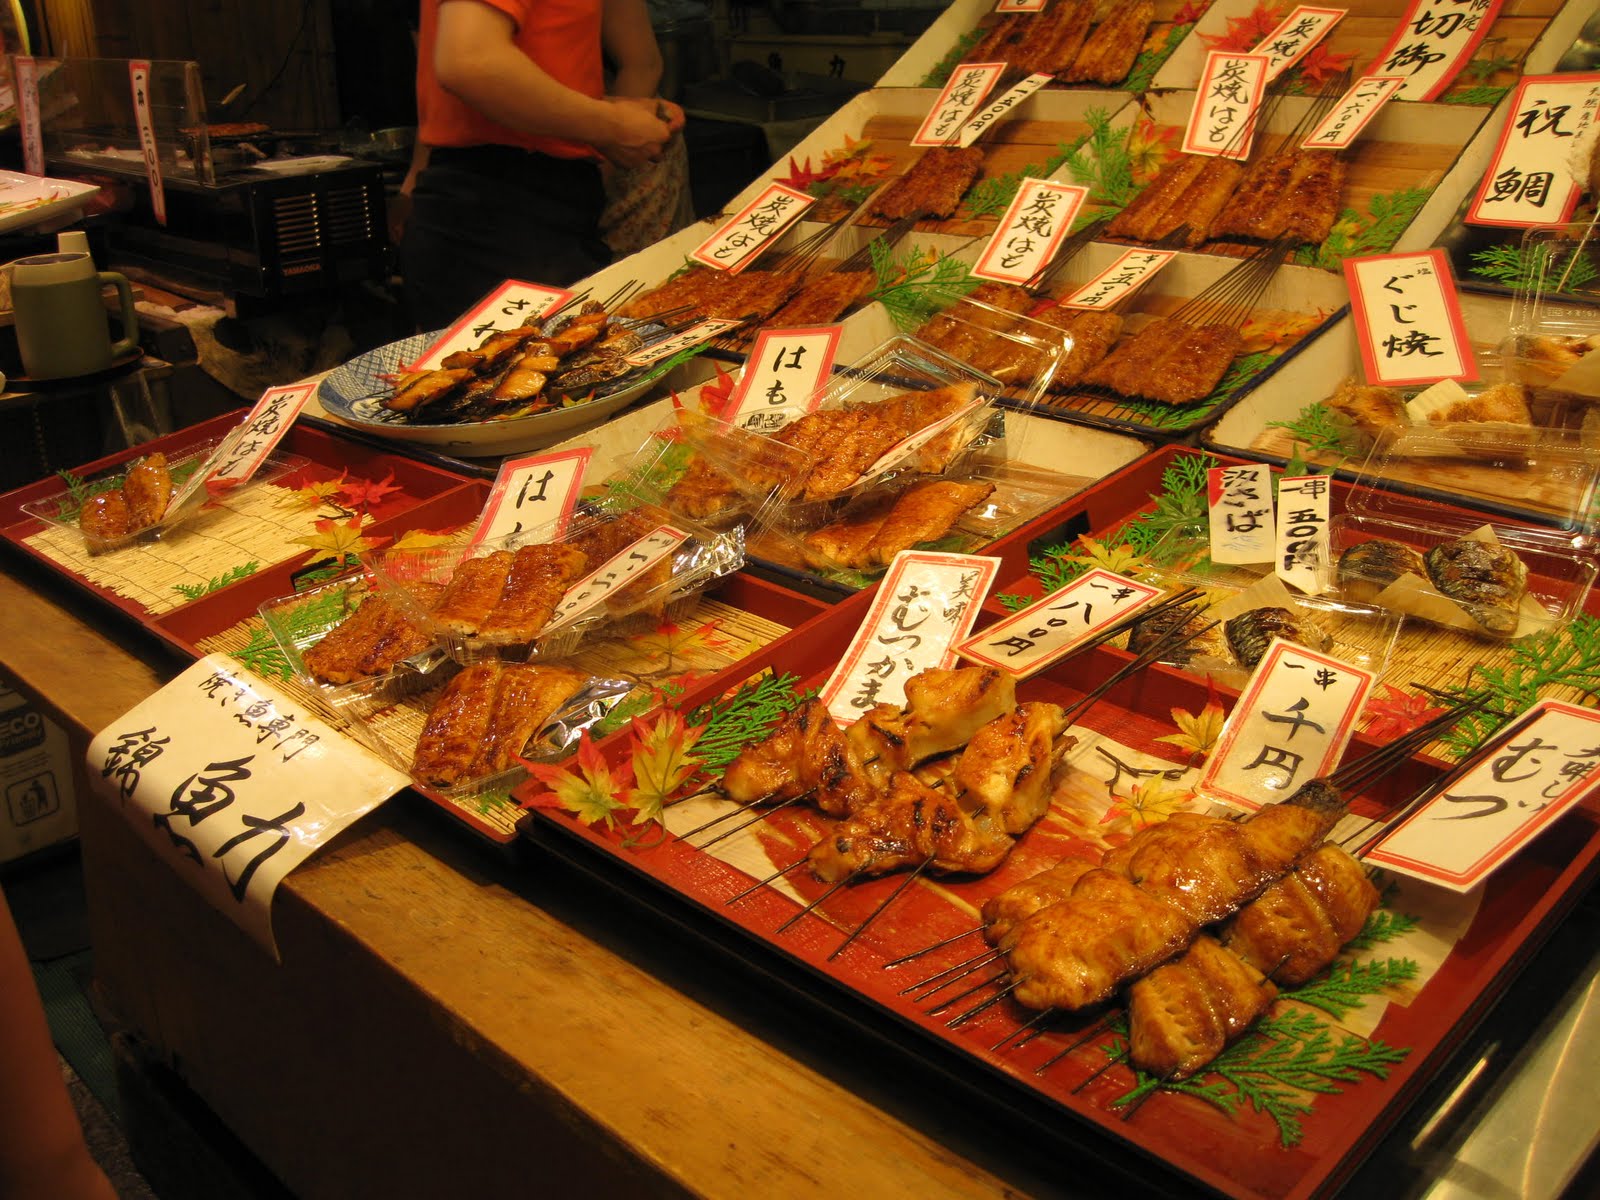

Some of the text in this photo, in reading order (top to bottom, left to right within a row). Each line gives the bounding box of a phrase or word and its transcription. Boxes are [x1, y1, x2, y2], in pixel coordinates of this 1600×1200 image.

[1264, 16, 1321, 67] 炭焼
[1485, 100, 1574, 208] 祝鯛
[1001, 191, 1062, 268] 炭焼はも
[466, 299, 531, 352] さわ
[1382, 274, 1445, 358] ぐじ焼
[1280, 480, 1326, 499] 一串
[1090, 582, 1137, 604] 一串
[1283, 661, 1337, 691] 一串
[1242, 696, 1326, 790] 千円
